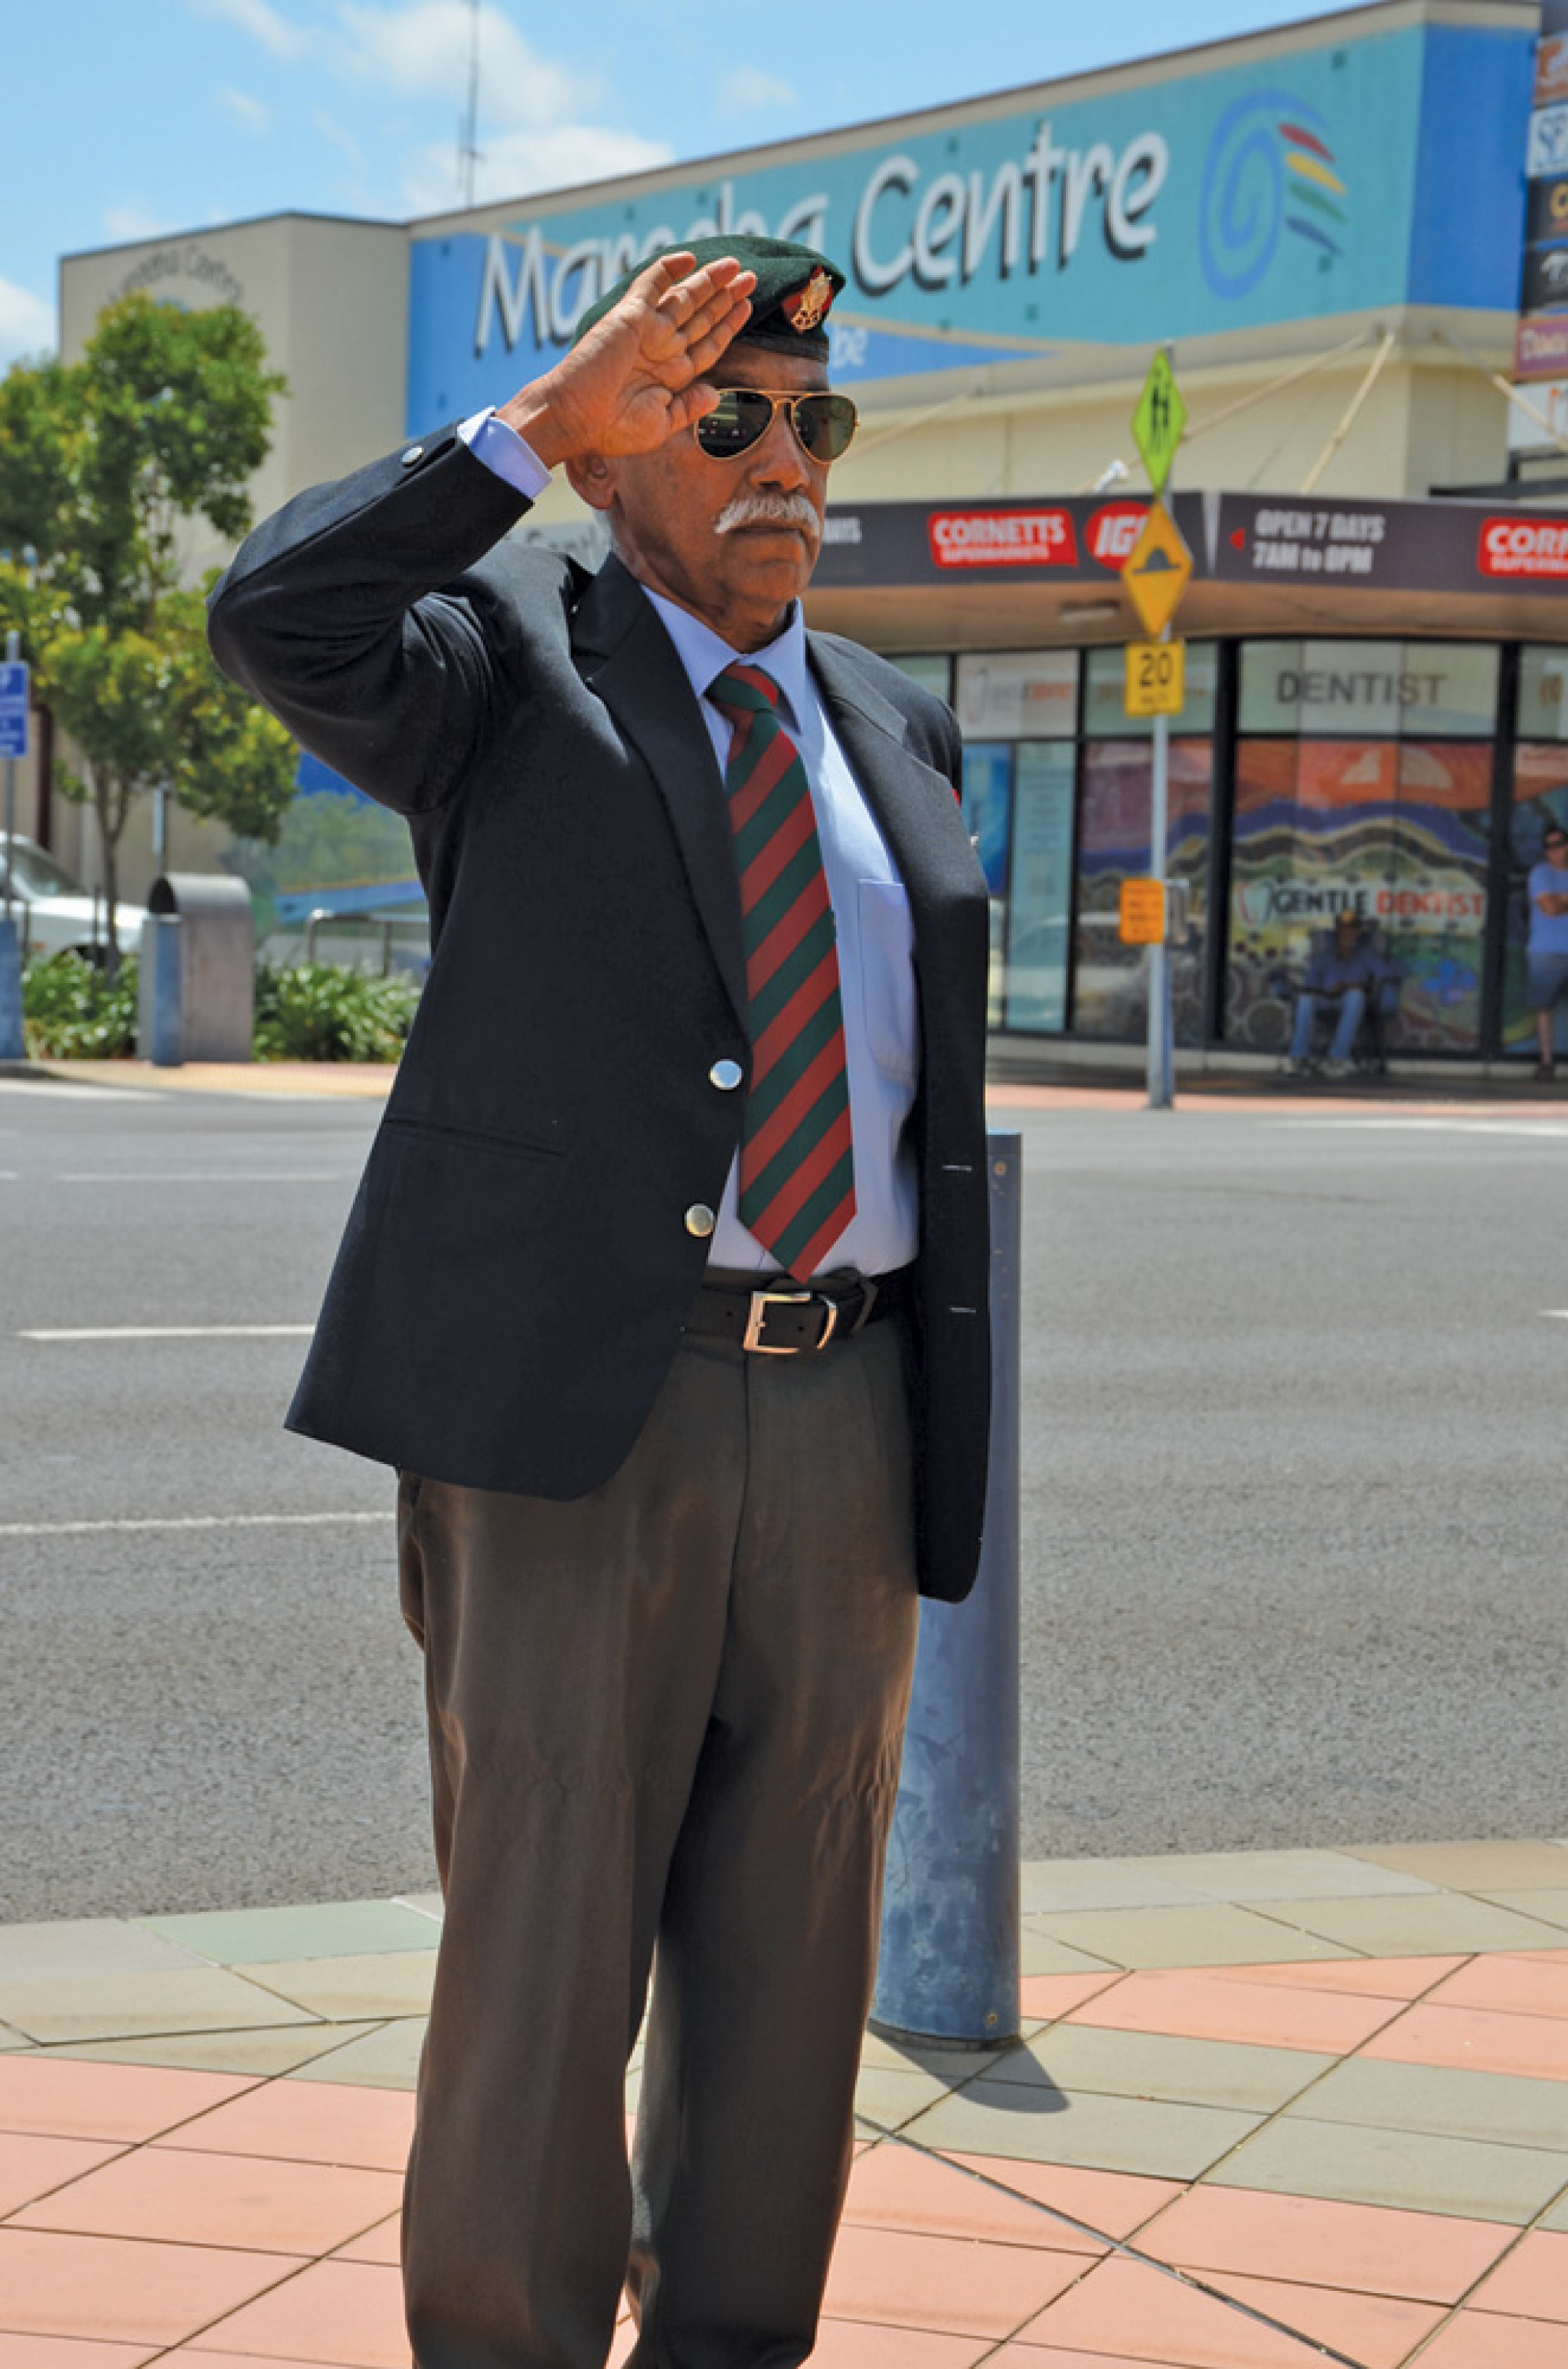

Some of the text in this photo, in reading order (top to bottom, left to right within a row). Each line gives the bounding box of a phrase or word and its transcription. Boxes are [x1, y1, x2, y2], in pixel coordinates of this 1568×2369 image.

[474, 118, 1169, 357] Marba Centre
[933, 515, 1067, 546] CORNETTS
[1255, 508, 1386, 544] OPEN 7 DAYS
[1487, 524, 1568, 554] COR
[1252, 541, 1300, 570] 7AM
[1302, 545, 1324, 572] to
[1138, 651, 1174, 688] 20
[1276, 670, 1448, 706] DENTIST
[1272, 889, 1485, 919] GENTLE DENTIST
